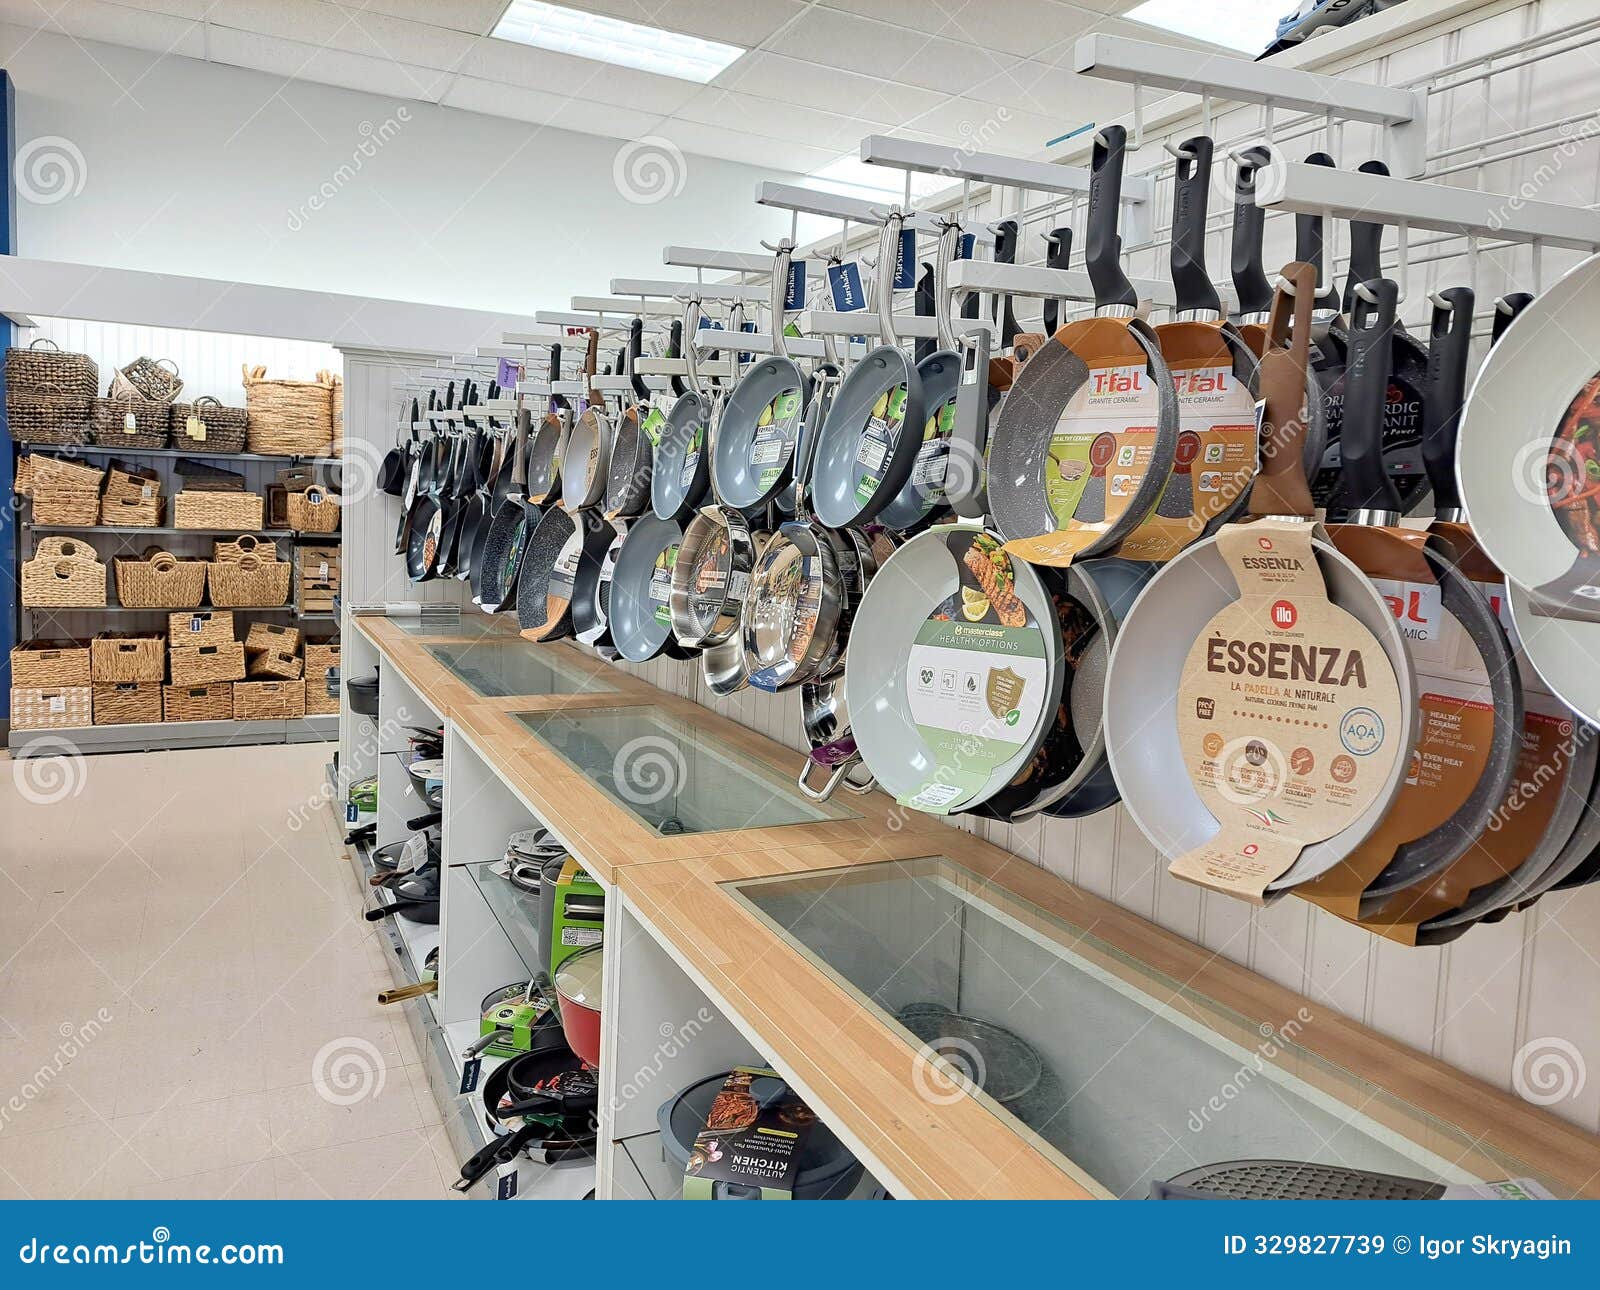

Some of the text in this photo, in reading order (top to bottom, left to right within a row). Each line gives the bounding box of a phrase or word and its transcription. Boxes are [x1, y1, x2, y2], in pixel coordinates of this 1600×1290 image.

[1088, 396, 1140, 405] GRANITE CERAMIC
[1193, 395, 1225, 404] CERAMIC
[1384, 401, 1420, 415] RDIC
[1384, 414, 1419, 427] ANIT
[1242, 555, 1305, 571] ÈSSENZA
[1276, 606, 1292, 623] illa
[963, 626, 1005, 637] masterclass
[939, 635, 1019, 650] HEALTHY OPTIONS
[1206, 630, 1368, 689] ÈSSENZA
[1230, 681, 1337, 704] LA PADELLA AL NATURALE
[1430, 711, 1463, 723] HEALTHY
[1428, 718, 1461, 732] CERAMIC
[1422, 760, 1443, 771] BASE
[1423, 752, 1464, 768] EVEN HEAT
[733, 1141, 792, 1156] Multi-Function Pan
[730, 1163, 786, 1179] AUTHENTIC
